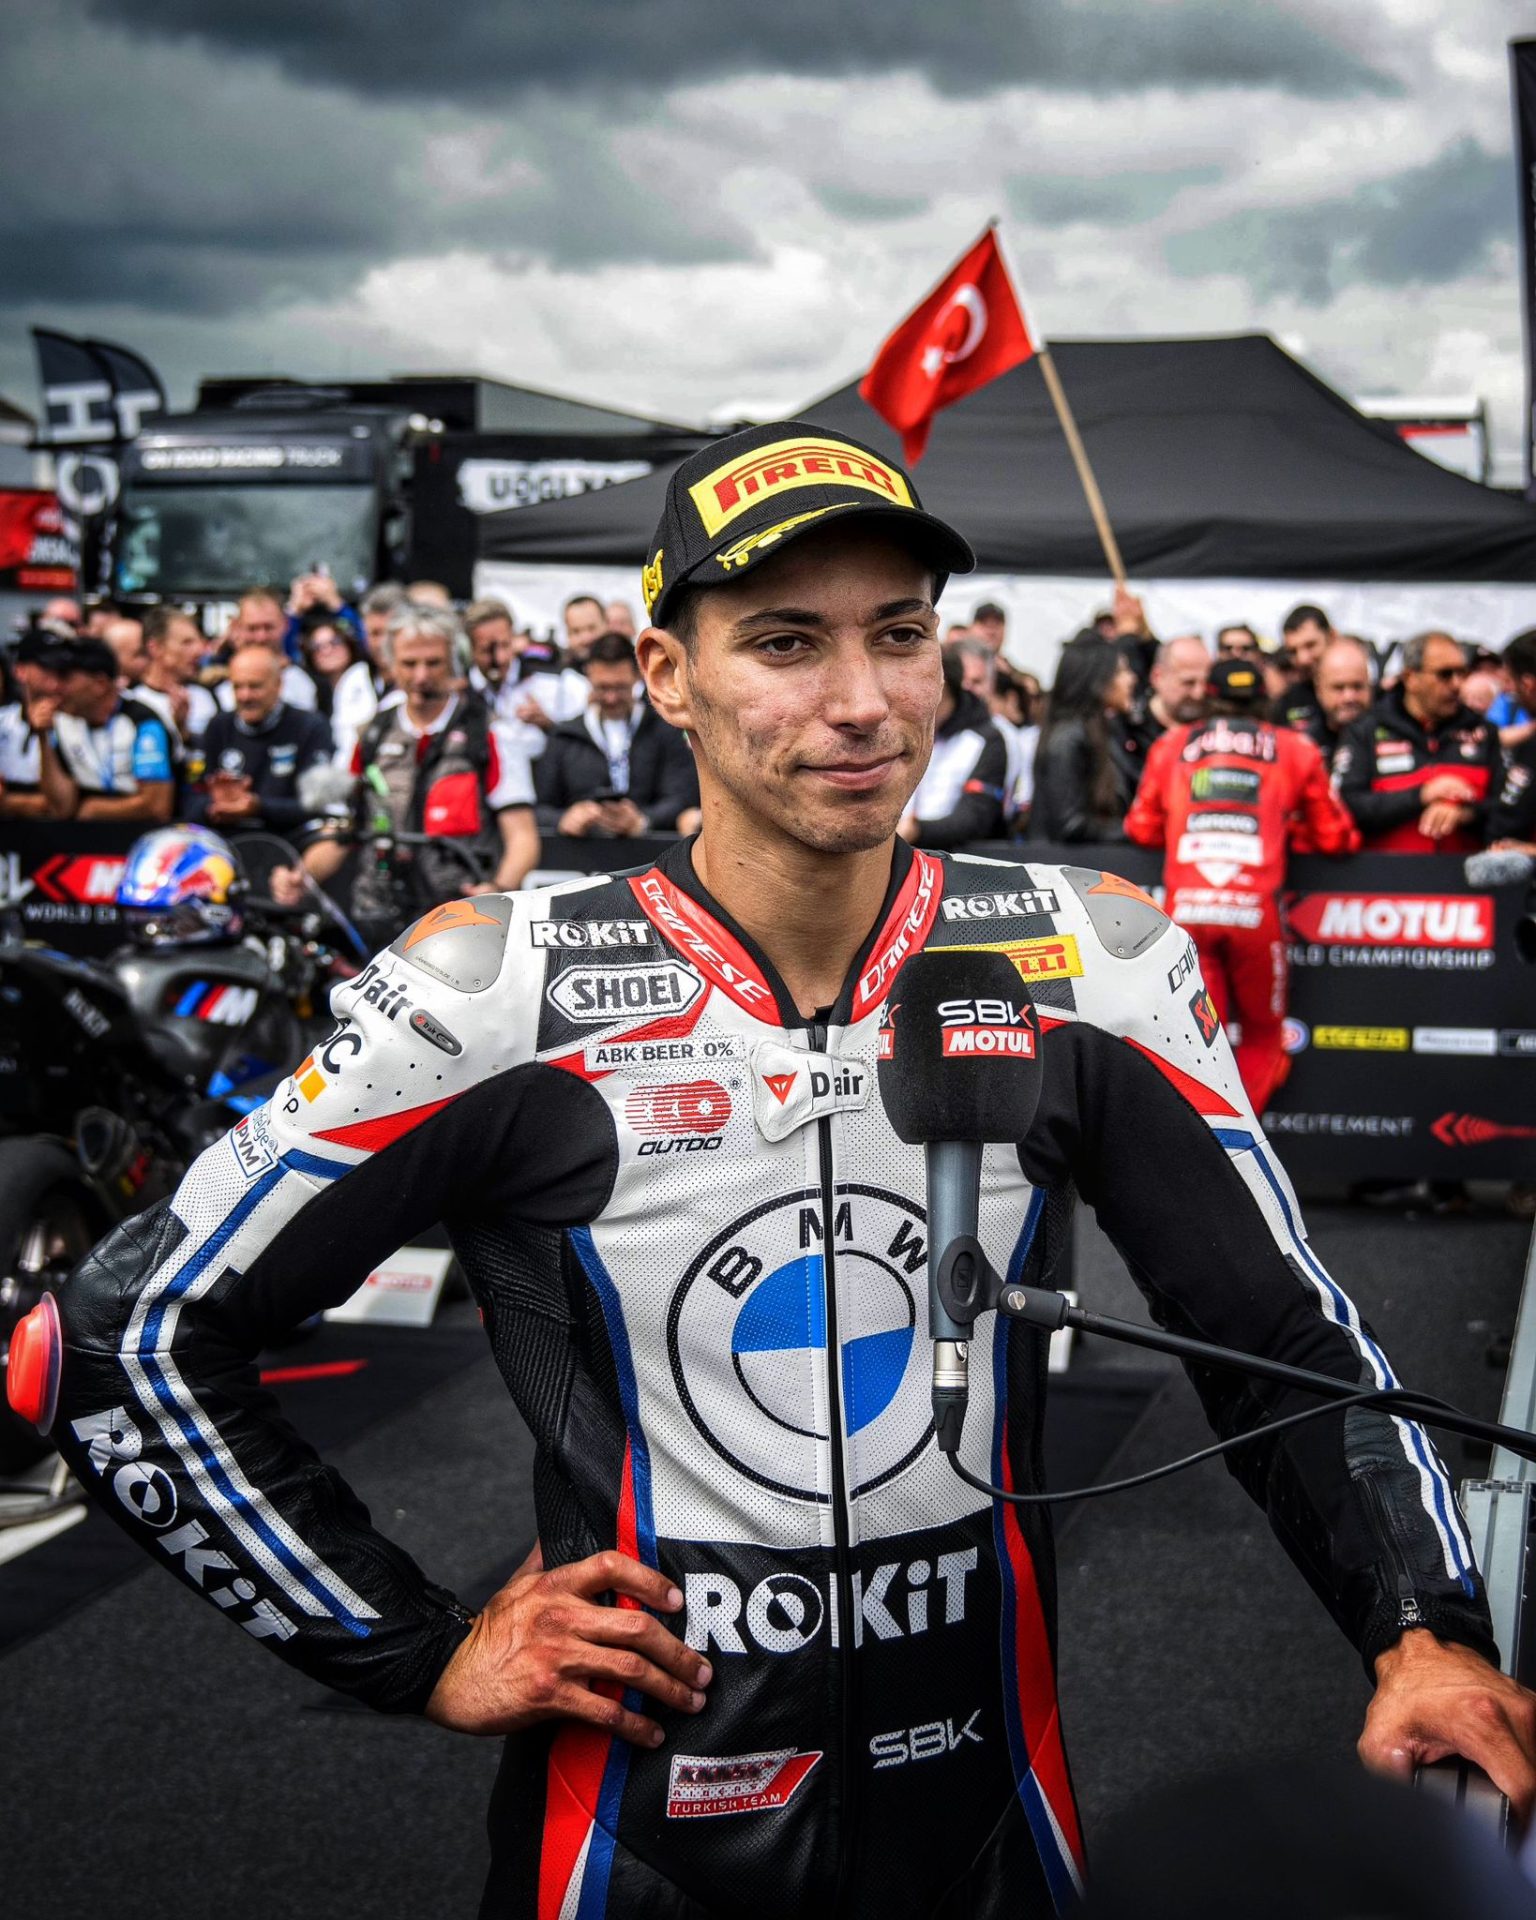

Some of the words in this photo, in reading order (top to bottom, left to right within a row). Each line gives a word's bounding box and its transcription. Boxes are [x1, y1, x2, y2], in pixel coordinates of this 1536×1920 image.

[713, 446, 897, 513] PIRELLI
[1318, 898, 1485, 942] MOTUL
[1329, 946, 1496, 970] CHAMPIONSHIP
[572, 972, 682, 1011] SHOEI
[938, 1000, 1033, 1028] SBK
[595, 1047, 637, 1064] ABK
[642, 1044, 694, 1062] BEER
[703, 1042, 734, 1058] 0%
[949, 1030, 1032, 1054] MOTUL
[1261, 1111, 1414, 1137] EXCITEMENT
[235, 1126, 261, 1168] PVM
[637, 1137, 723, 1156] OUTDO
[869, 1708, 984, 1770] SBK
[673, 1800, 737, 1815] TURKISH
[742, 1793, 782, 1807] TEAM
